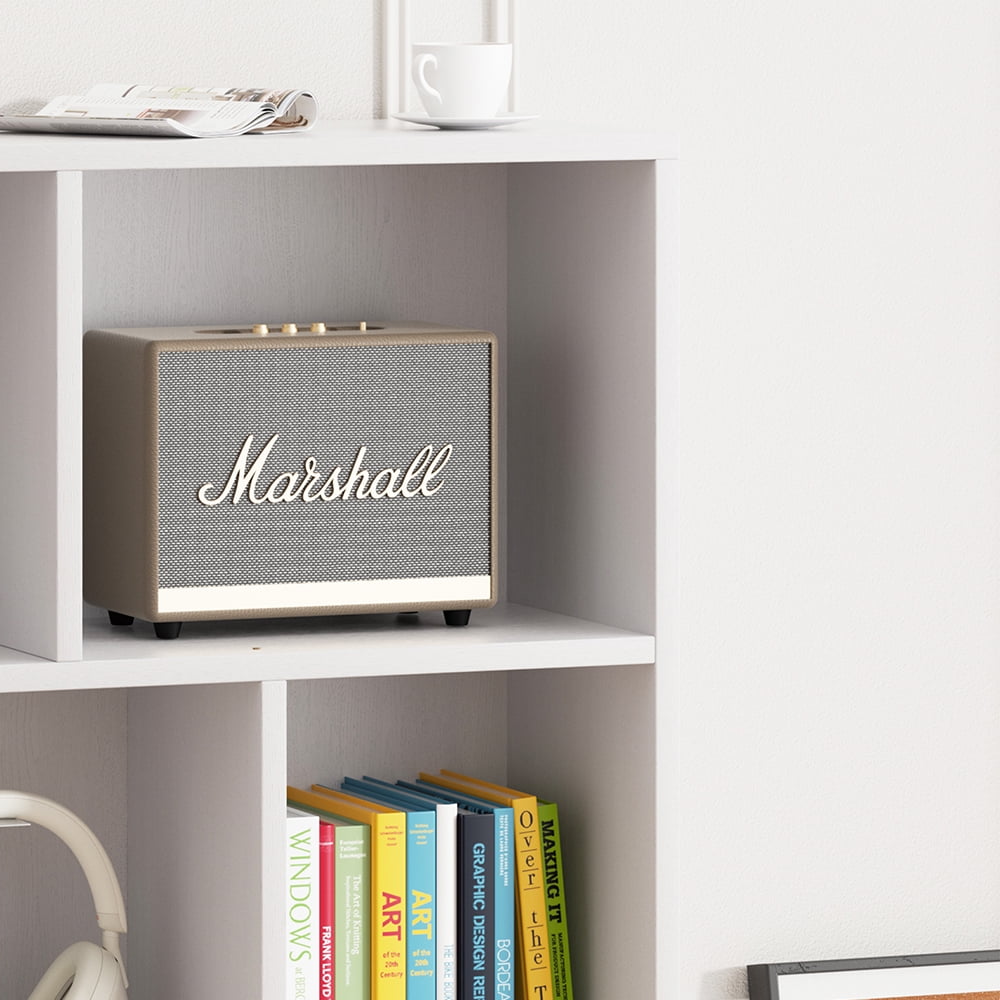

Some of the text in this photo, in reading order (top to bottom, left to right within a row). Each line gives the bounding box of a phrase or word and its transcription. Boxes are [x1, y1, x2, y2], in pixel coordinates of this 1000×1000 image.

[198, 434, 452, 506] Marshall
[289, 828, 312, 962] WINDOWS
[473, 843, 485, 911] GRAPHIC
[519, 810, 536, 886] Over
[531, 911, 543, 965] the
[541, 819, 562, 923] MAKING IT
[350, 875, 361, 955] The Art of Knitting
[382, 892, 401, 941] ART
[411, 890, 432, 940] ART
[473, 915, 485, 971] DESIGN
[322, 926, 332, 961] FRANK
[443, 944, 454, 958] THE
[322, 963, 332, 998] LLOYD
[380, 971, 403, 979] Century
